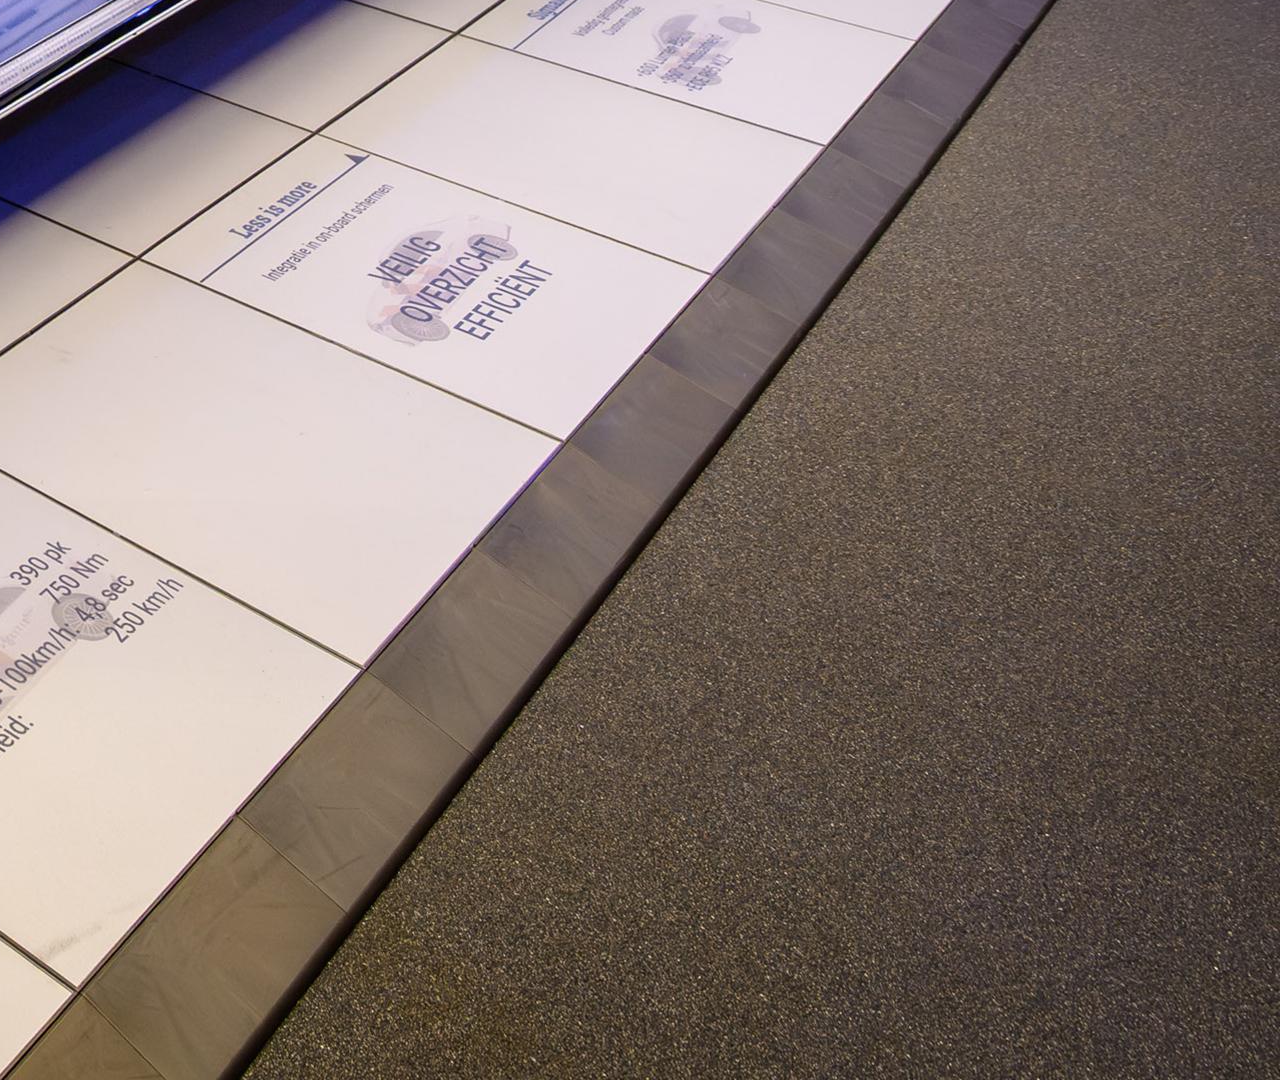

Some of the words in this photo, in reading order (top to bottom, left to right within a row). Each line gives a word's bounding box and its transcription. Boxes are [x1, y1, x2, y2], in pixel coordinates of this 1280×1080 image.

[228, 214, 273, 239] Less
[258, 204, 286, 218] is
[277, 180, 318, 208] more
[262, 246, 312, 282] Integratie
[302, 239, 321, 251] in
[315, 211, 357, 243] on-board
[351, 183, 395, 215] schermen
[367, 236, 442, 284] VEILIG
[399, 236, 508, 323] OVERZICHT
[453, 259, 553, 341] EFFICIËNT
[9, 555, 51, 587] 390
[45, 538, 72, 565] pk
[39, 571, 81, 605] 750
[75, 550, 109, 581] Nm
[77, 596, 107, 623] 4,8
[101, 573, 135, 602] sec
[104, 609, 146, 644] 250
[138, 575, 185, 614] km/h
